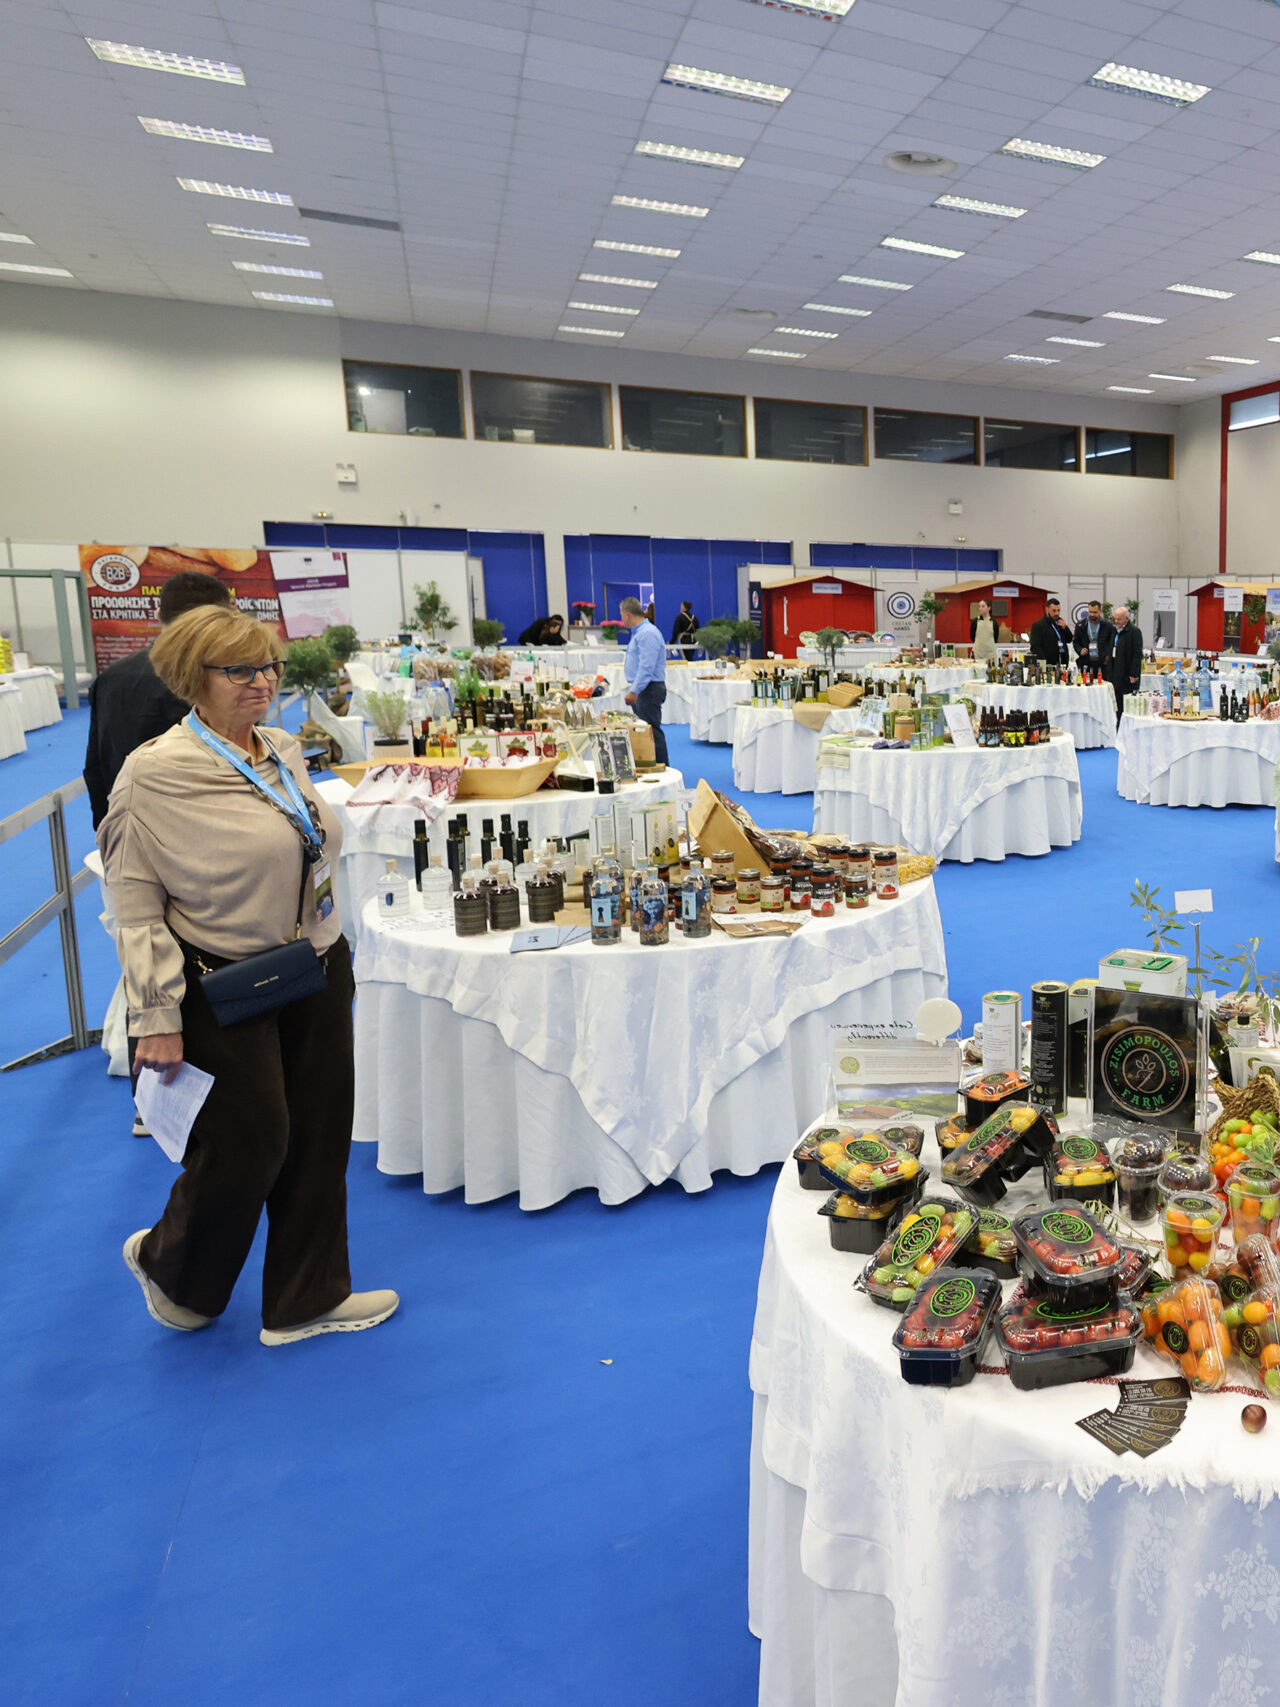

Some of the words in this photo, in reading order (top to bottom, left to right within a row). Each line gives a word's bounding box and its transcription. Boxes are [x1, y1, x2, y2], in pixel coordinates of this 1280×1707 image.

[106, 566, 126, 580] B2B
[91, 596, 151, 609] ΠΡΟΩΘΗΣΗΣ
[92, 609, 108, 619] ΣΤΑ
[110, 609, 147, 619] ΚΡΗΤΙΚΑ
[1109, 1034, 1180, 1077] ZISIMOPOULOS
[1121, 1088, 1165, 1107] FARM
